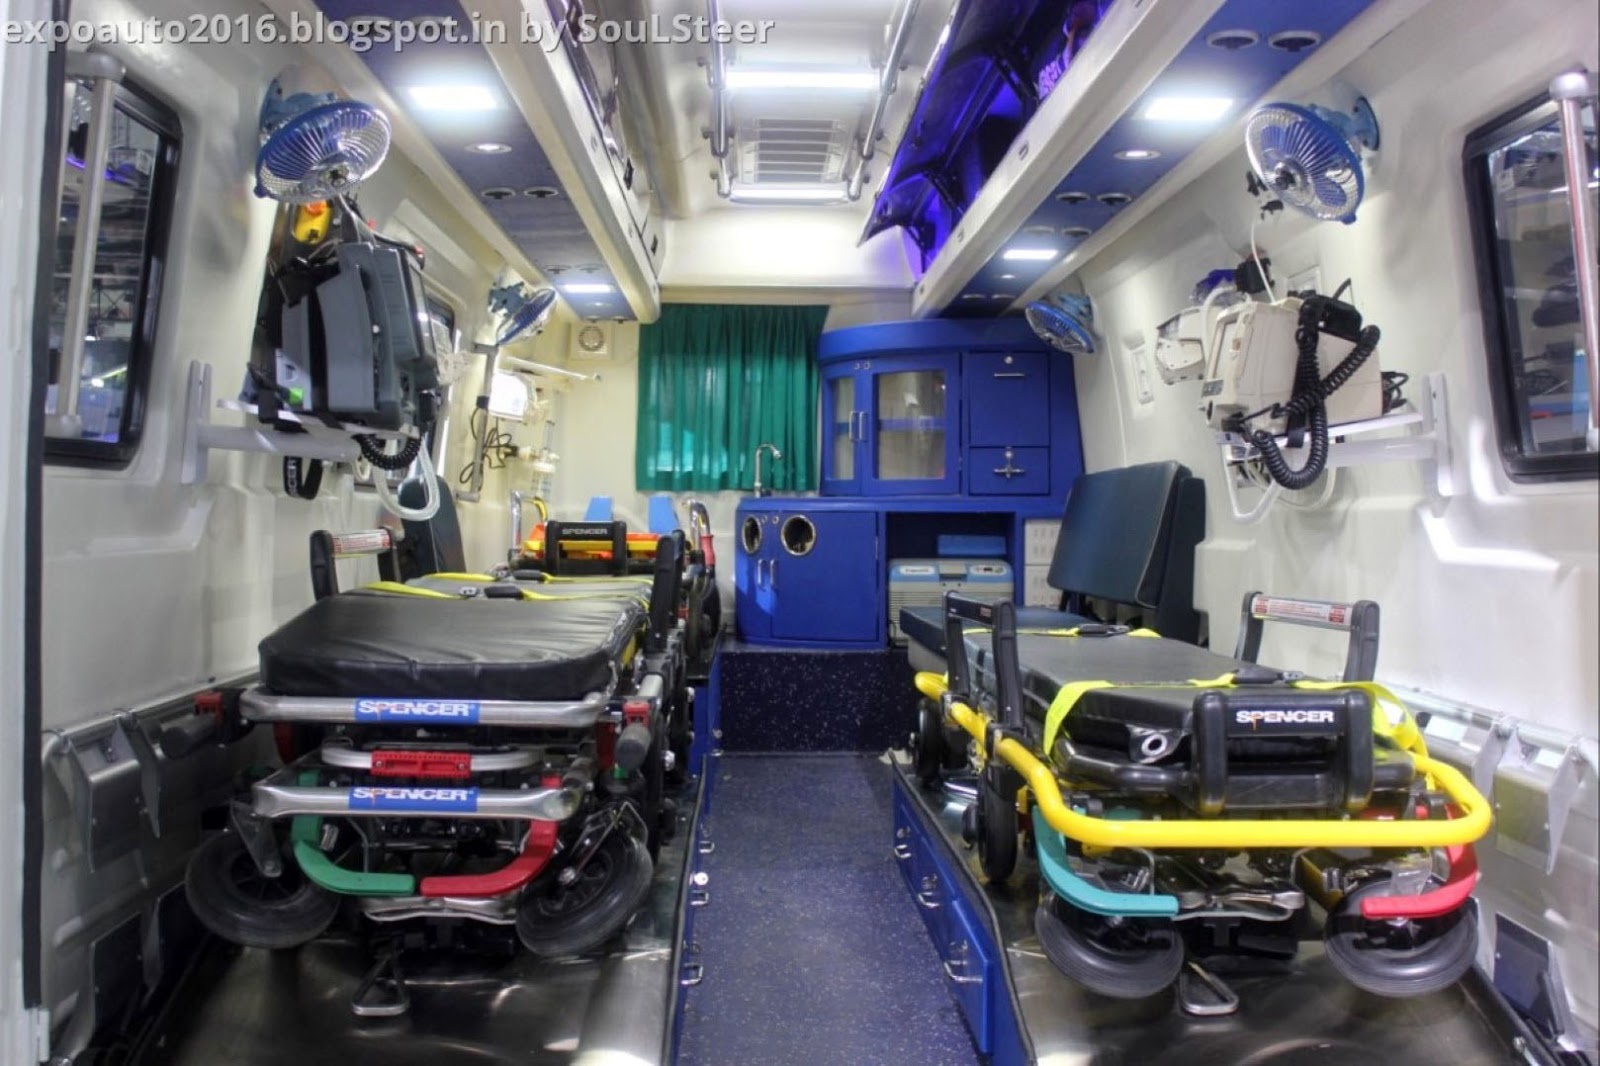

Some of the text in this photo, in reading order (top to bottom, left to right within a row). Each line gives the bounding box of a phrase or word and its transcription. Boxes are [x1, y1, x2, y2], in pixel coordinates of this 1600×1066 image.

[358, 700, 470, 719] SPENCER
[1235, 710, 1335, 730] SPENCER
[352, 787, 468, 804] SPENCER
